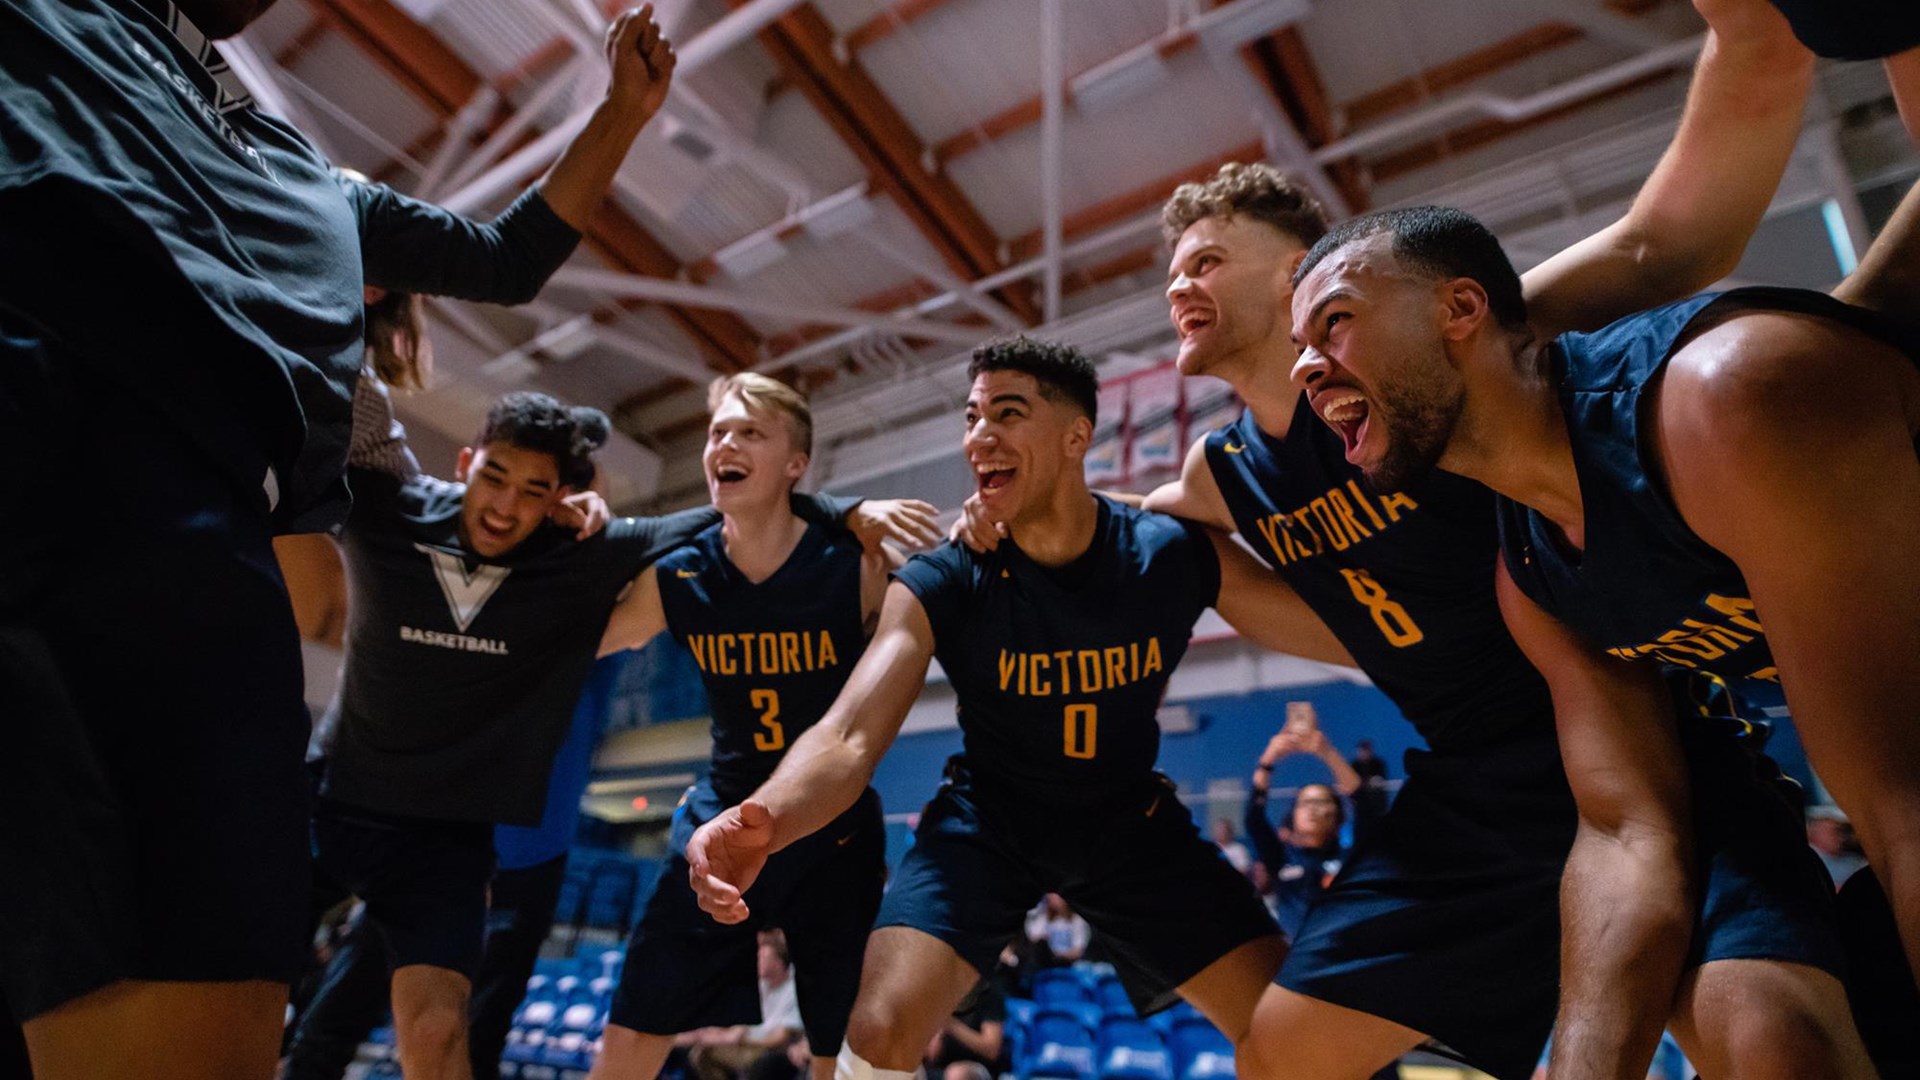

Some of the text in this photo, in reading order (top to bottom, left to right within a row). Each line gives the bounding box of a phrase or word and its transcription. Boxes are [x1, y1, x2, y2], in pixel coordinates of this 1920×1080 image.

[1256, 479, 1419, 566] VICTORIA
[1339, 568, 1424, 648] 8
[400, 625, 509, 655] BASKETBALL
[687, 630, 838, 675] VICTORIA
[998, 636, 1163, 696] VICTORIA
[750, 689, 785, 752] 3
[1063, 703, 1098, 760] 0
